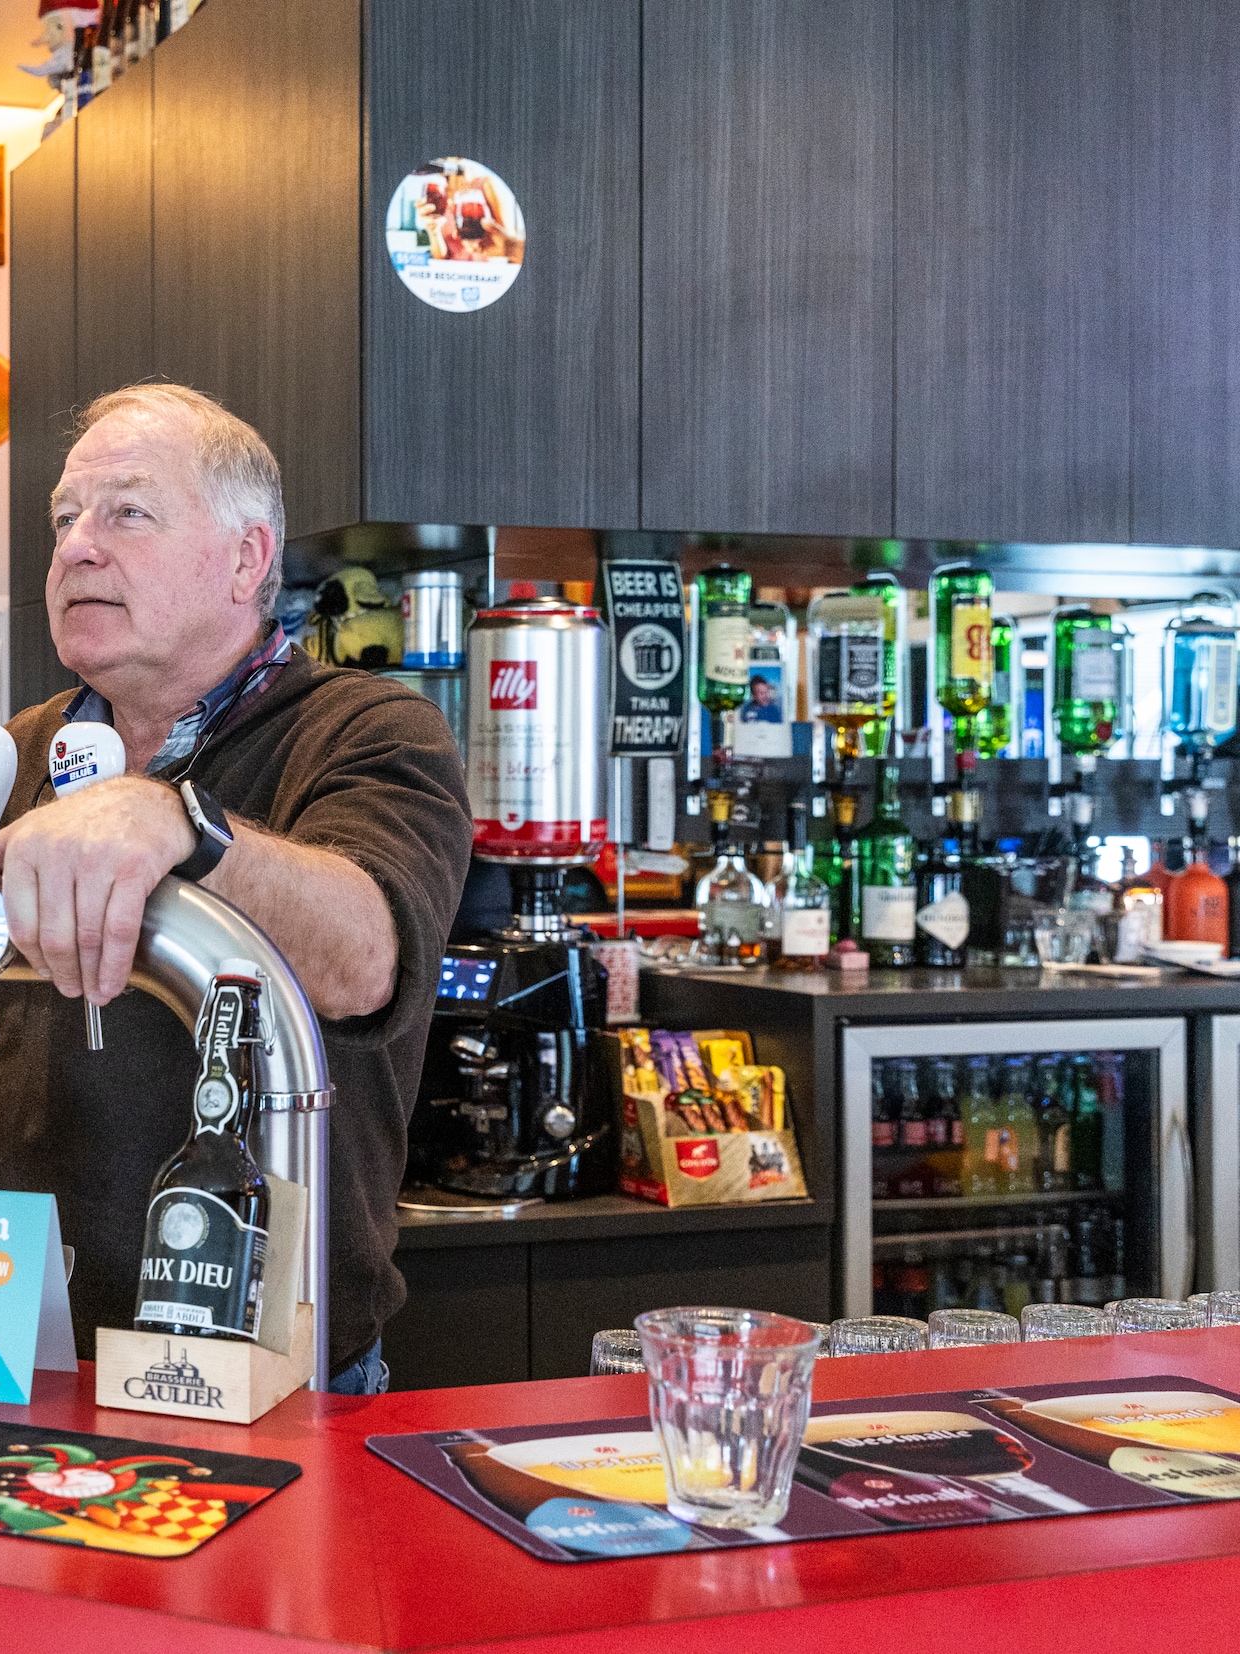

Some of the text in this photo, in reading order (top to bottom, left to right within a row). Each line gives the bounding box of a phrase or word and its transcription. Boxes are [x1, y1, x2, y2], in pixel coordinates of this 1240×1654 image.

[611, 571, 679, 598] BEER IS
[614, 602, 682, 619] CHEAPER
[491, 667, 536, 708] illy
[631, 696, 670, 712] THAN
[614, 715, 683, 745] THERAPY
[52, 751, 93, 774] Jupiler
[69, 765, 95, 782] BLUE
[212, 1000, 236, 1060] TRIPLE
[140, 1257, 234, 1290] PAIX DIEU
[146, 1371, 203, 1387] BRASSERIE
[123, 1376, 225, 1409] CAULIER
[1093, 1408, 1228, 1426] Westmalle
[832, 1429, 973, 1448] Westmalle
